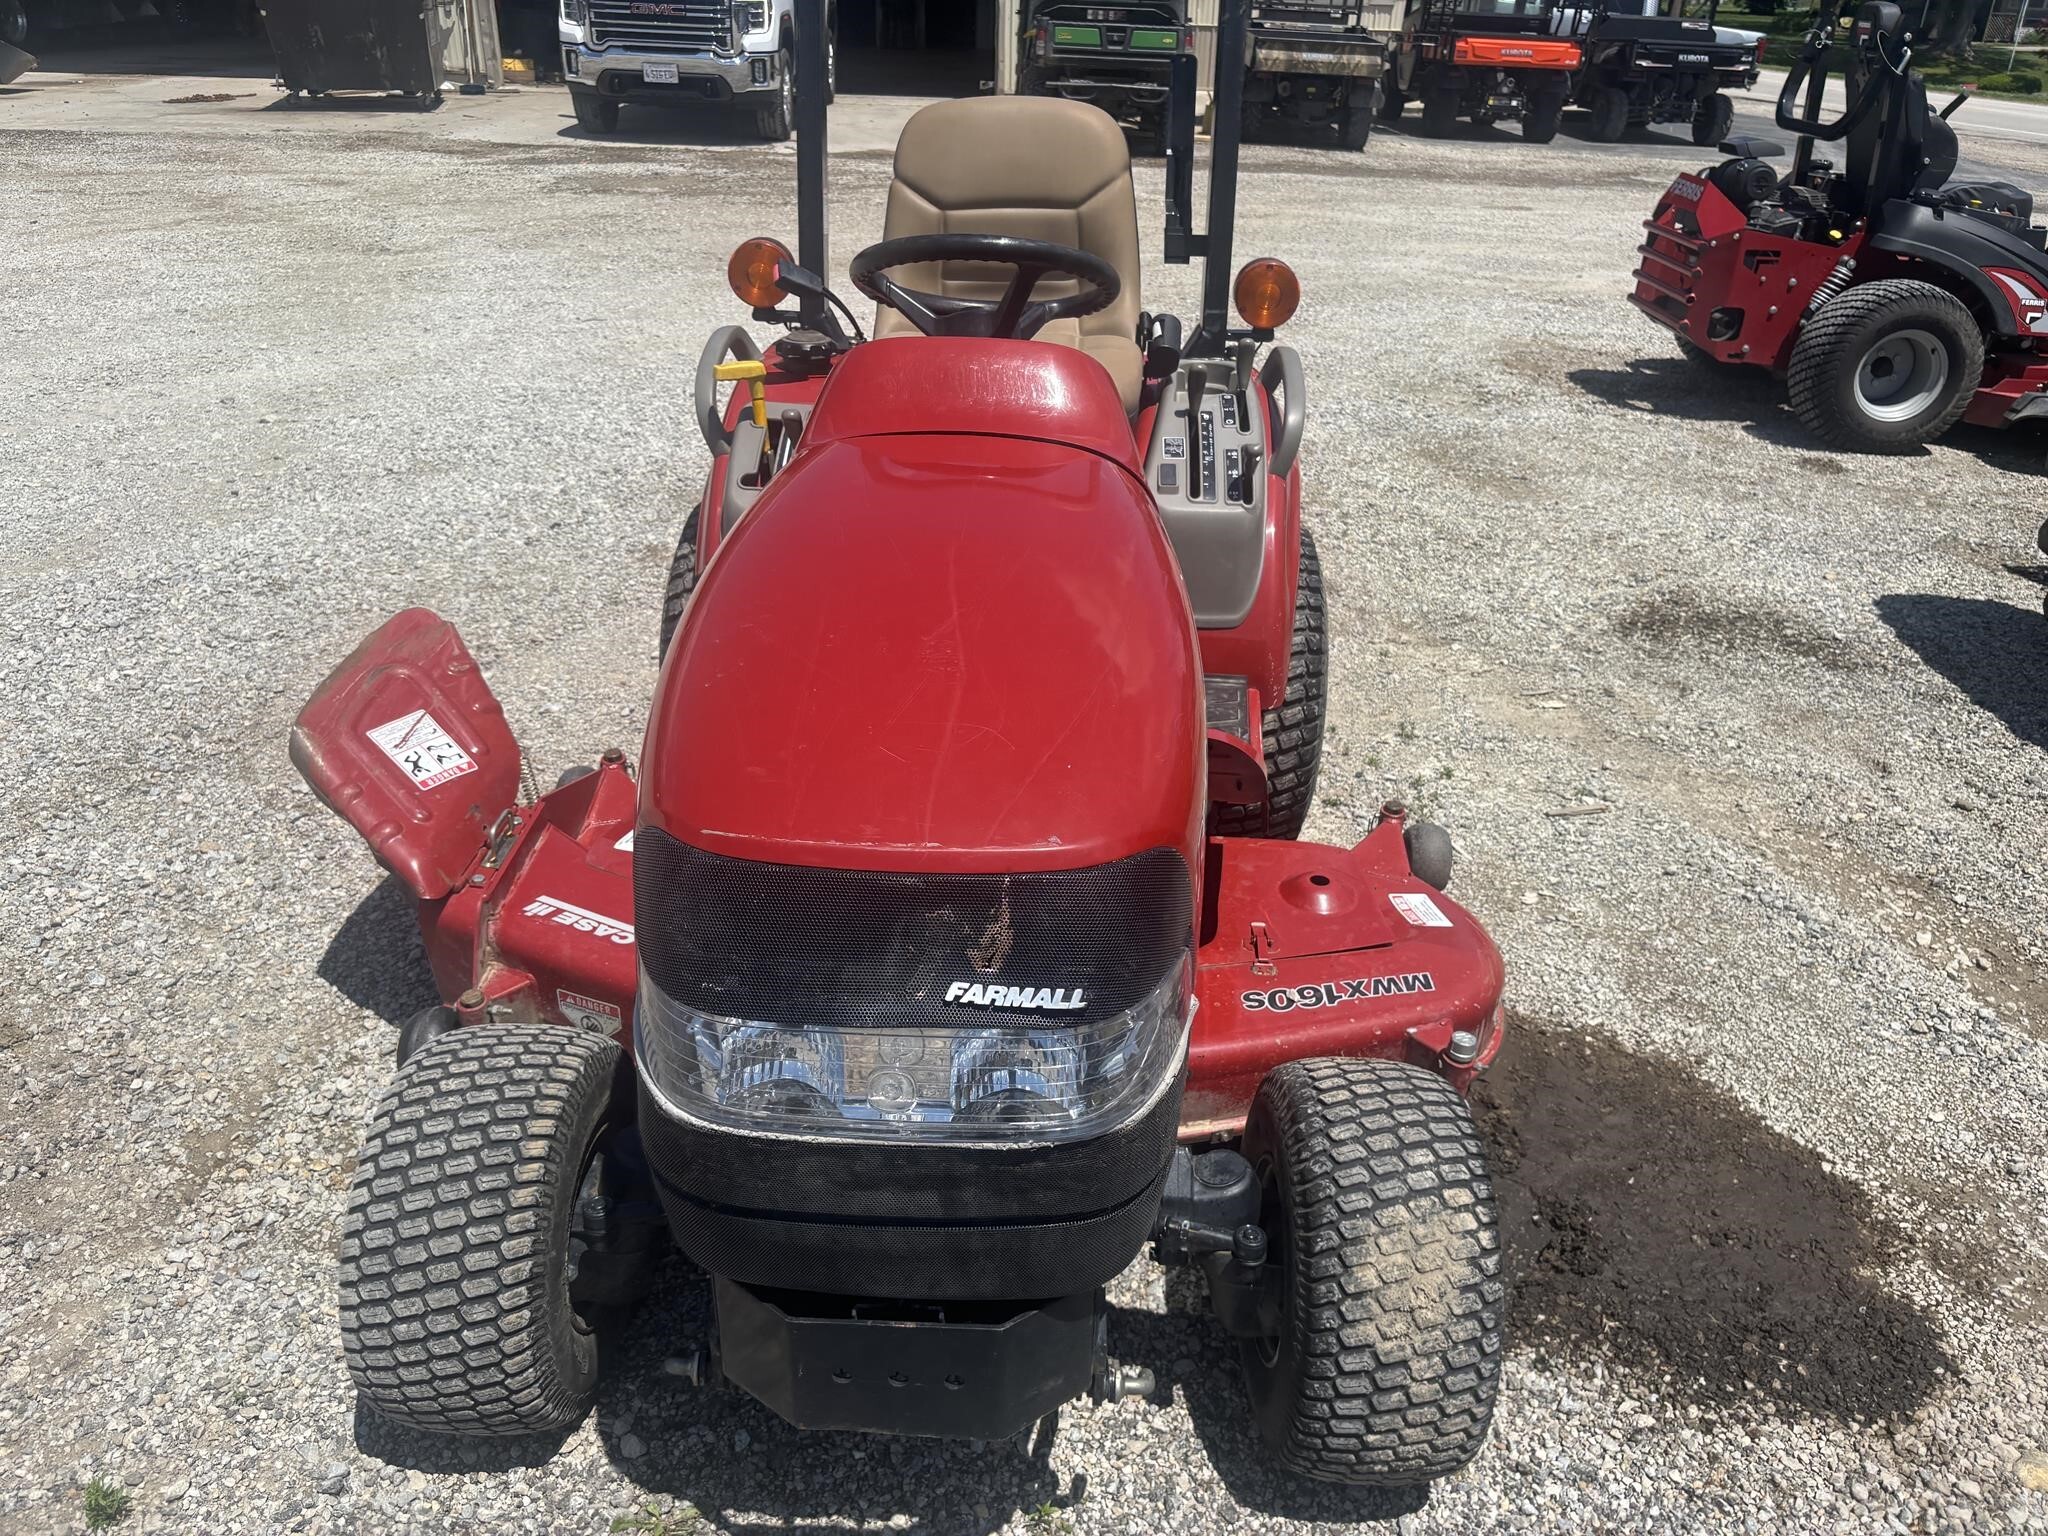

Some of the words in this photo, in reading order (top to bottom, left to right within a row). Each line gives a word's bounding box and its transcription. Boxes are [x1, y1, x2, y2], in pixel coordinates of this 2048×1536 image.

[630, 2, 686, 16] GMC
[1501, 48, 1533, 57] KUBOTA
[1677, 53, 1710, 63] KUBOTA
[1670, 178, 1703, 201] FERRIS
[2021, 299, 2045, 307] FERRIS
[425, 767, 462, 786] DANGER
[551, 911, 636, 944] CASE
[944, 981, 1088, 1010] FARMALL
[1241, 972, 1435, 1013] MWX160S
[575, 997, 612, 1015] DANGER
